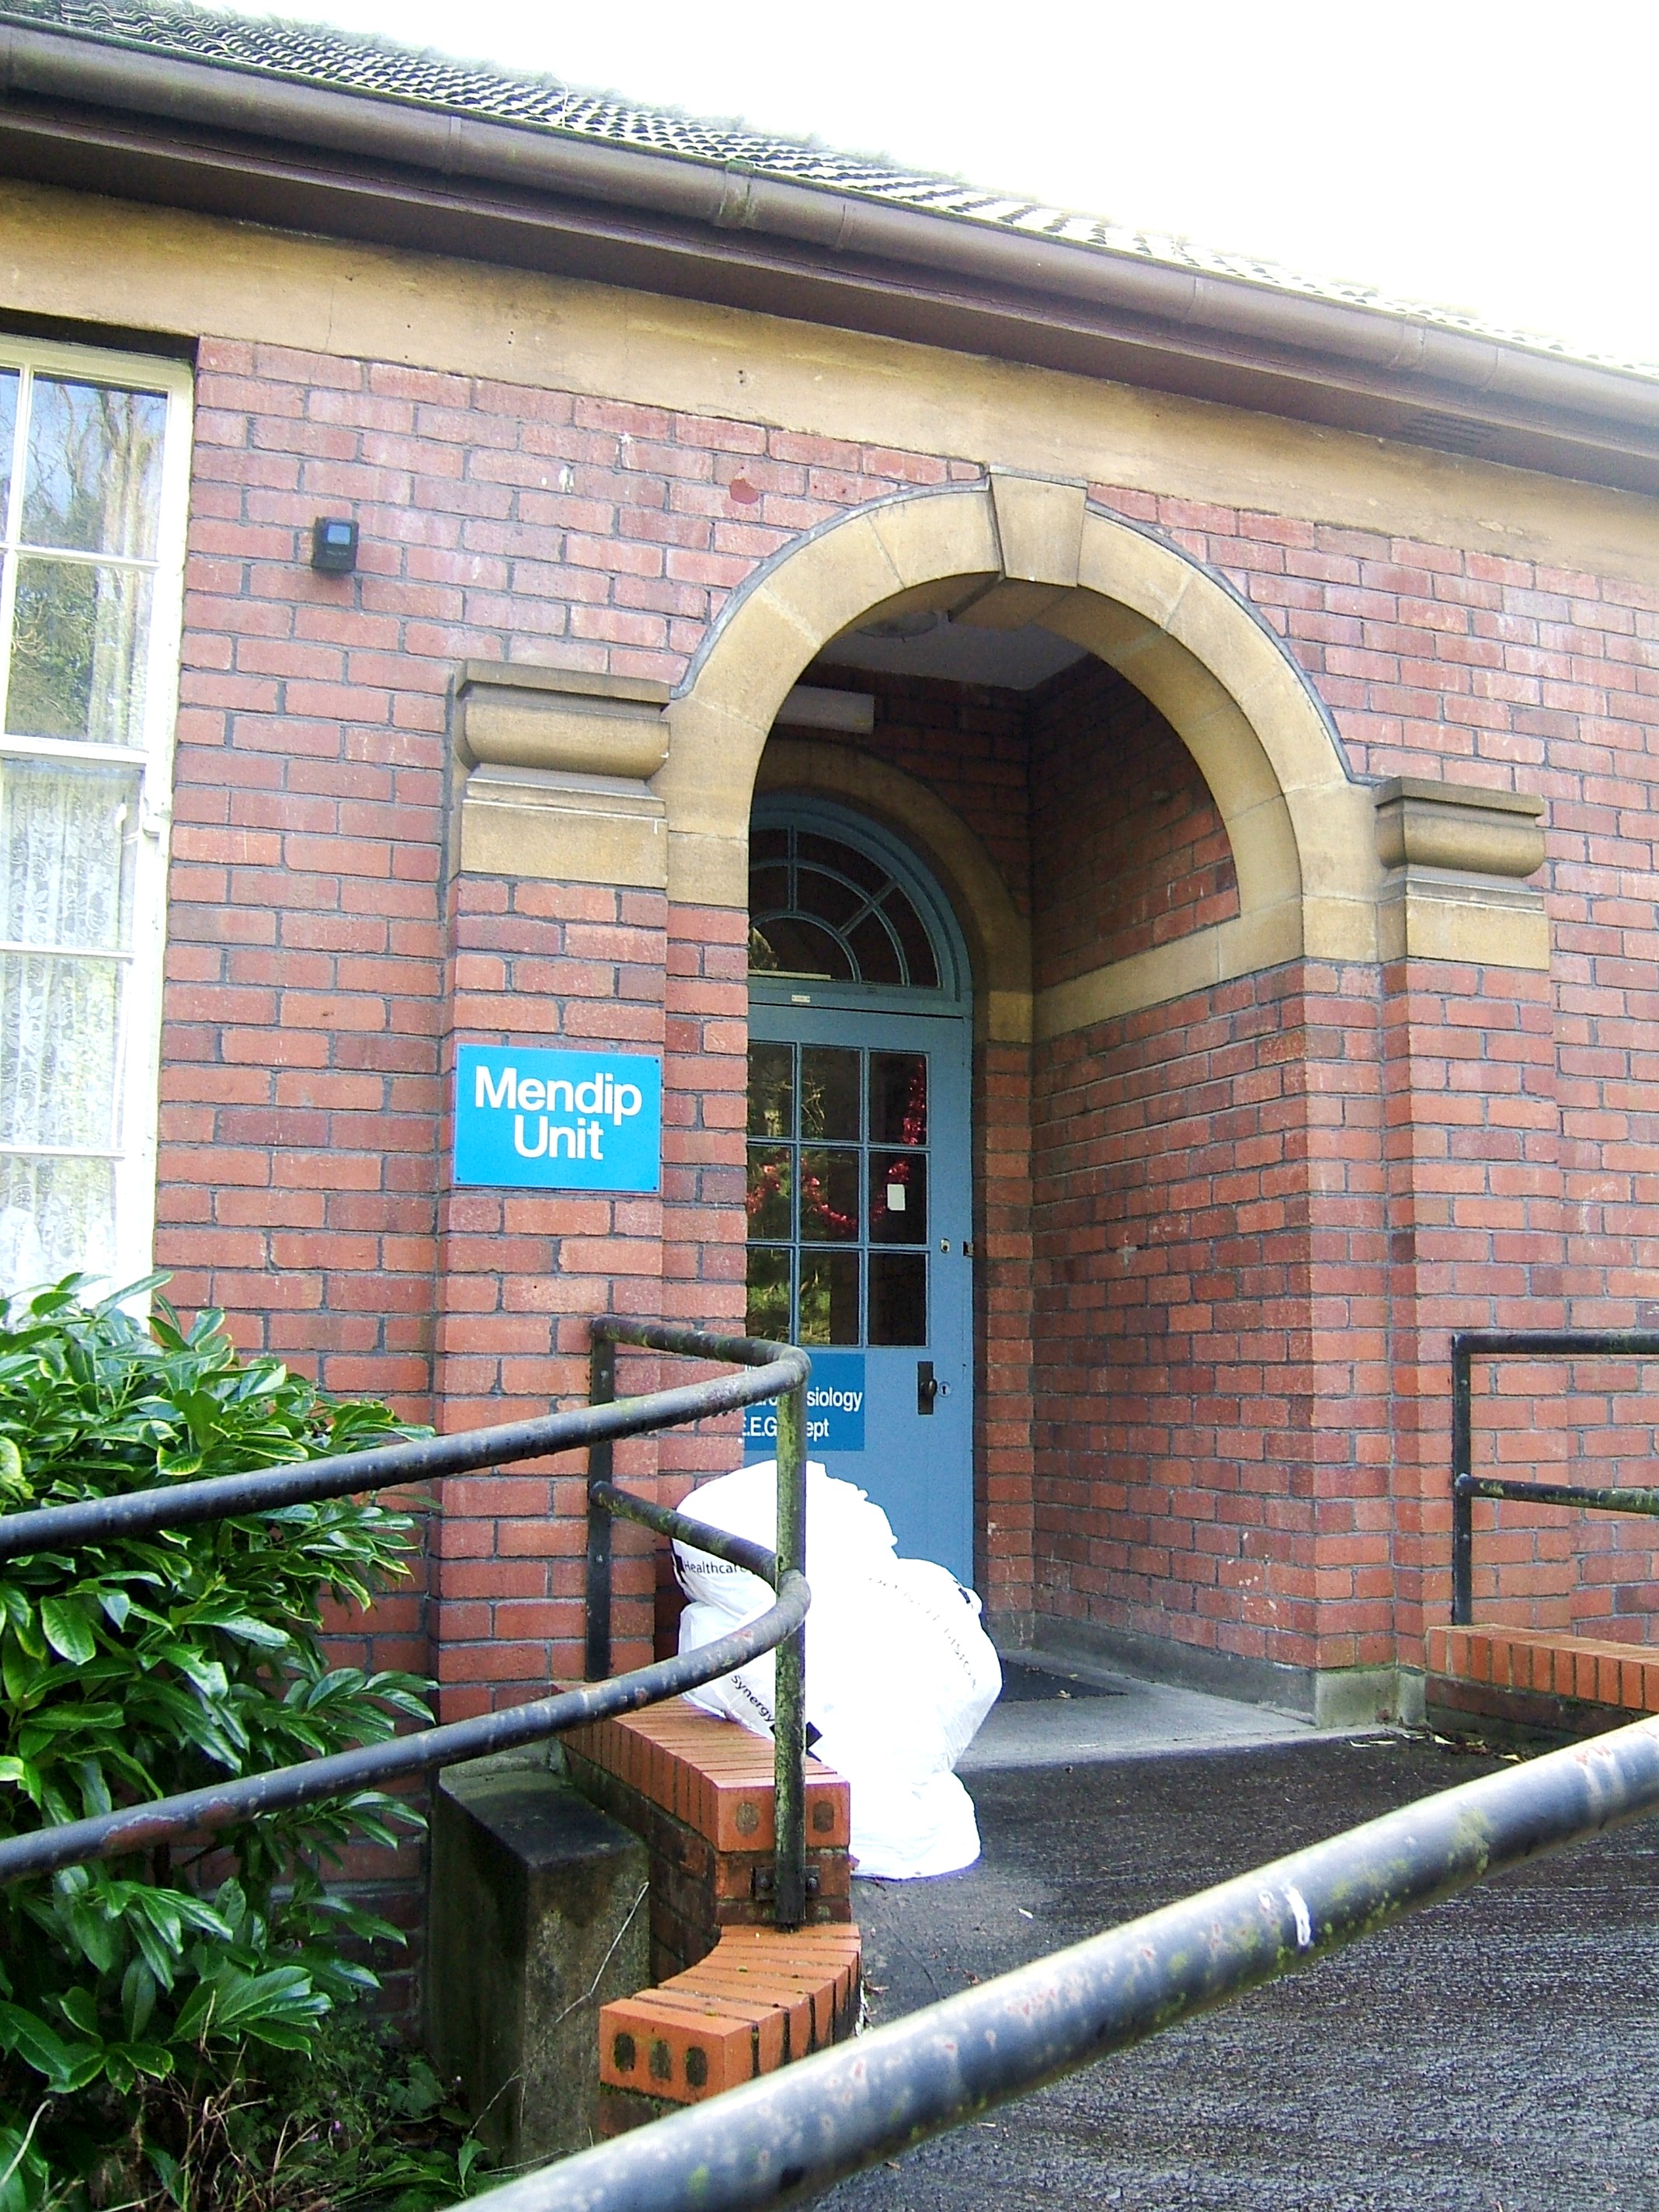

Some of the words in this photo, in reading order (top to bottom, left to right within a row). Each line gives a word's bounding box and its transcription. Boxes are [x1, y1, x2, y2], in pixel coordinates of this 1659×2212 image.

[475, 1065, 642, 1125] Mendip
[514, 1114, 603, 1160] Unit
[806, 1418, 829, 1442] ept
[731, 1675, 775, 1722] Synergy
